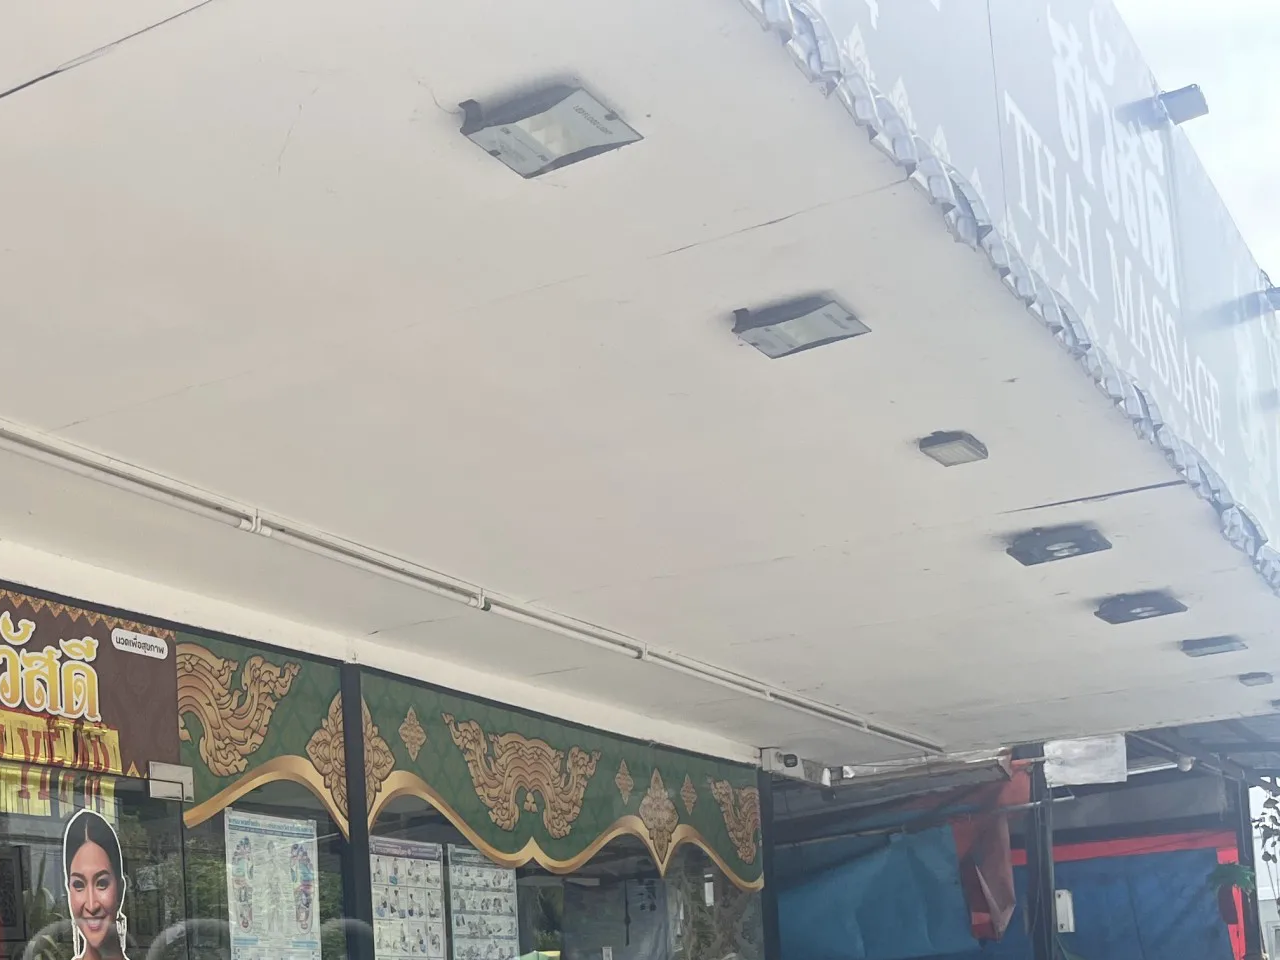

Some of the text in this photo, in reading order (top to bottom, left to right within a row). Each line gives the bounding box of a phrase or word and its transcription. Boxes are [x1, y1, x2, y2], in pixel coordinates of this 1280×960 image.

[1005, 90, 1226, 456] THAI MASSAGE
[115, 634, 165, 655] นวดเพื่อสุขภาพ
